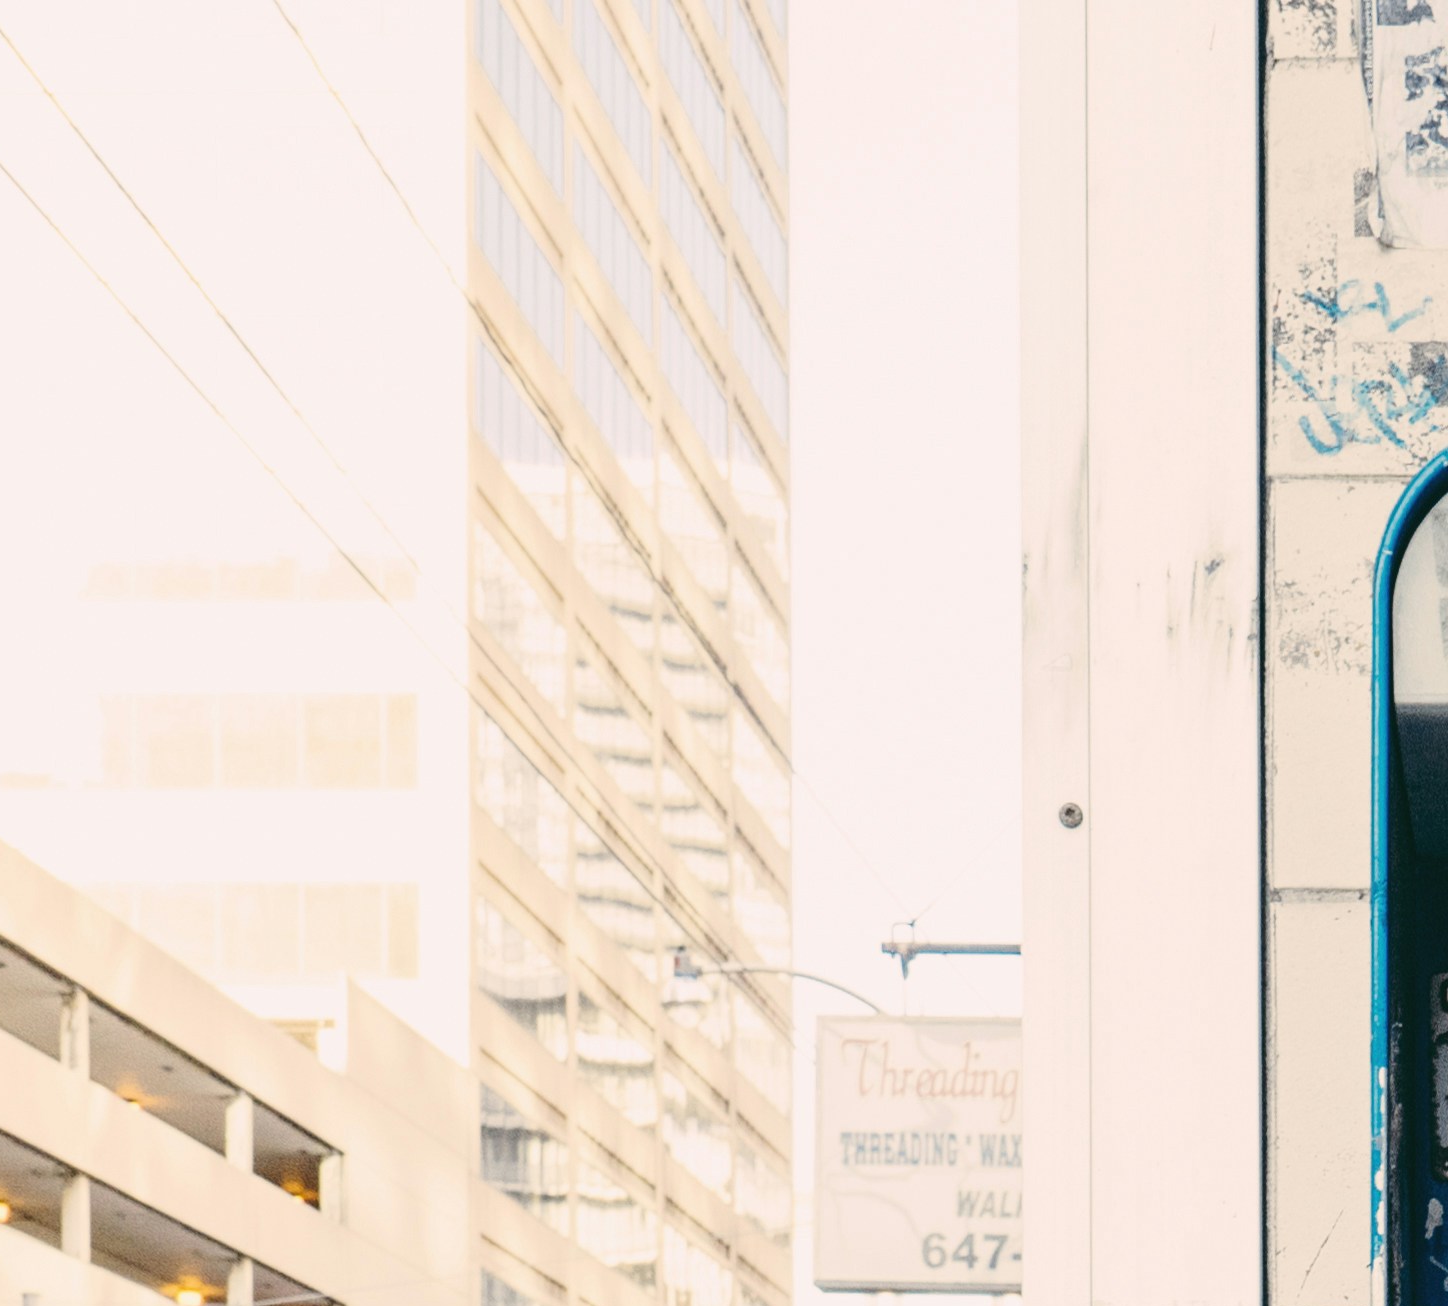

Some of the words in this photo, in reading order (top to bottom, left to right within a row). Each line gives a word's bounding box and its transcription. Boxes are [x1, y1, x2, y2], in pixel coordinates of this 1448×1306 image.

[841, 1038, 1020, 1124] Threading
[839, 1131, 958, 1167] THREADING
[979, 1133, 1022, 1168] WAX
[956, 1190, 1022, 1219] WAL
